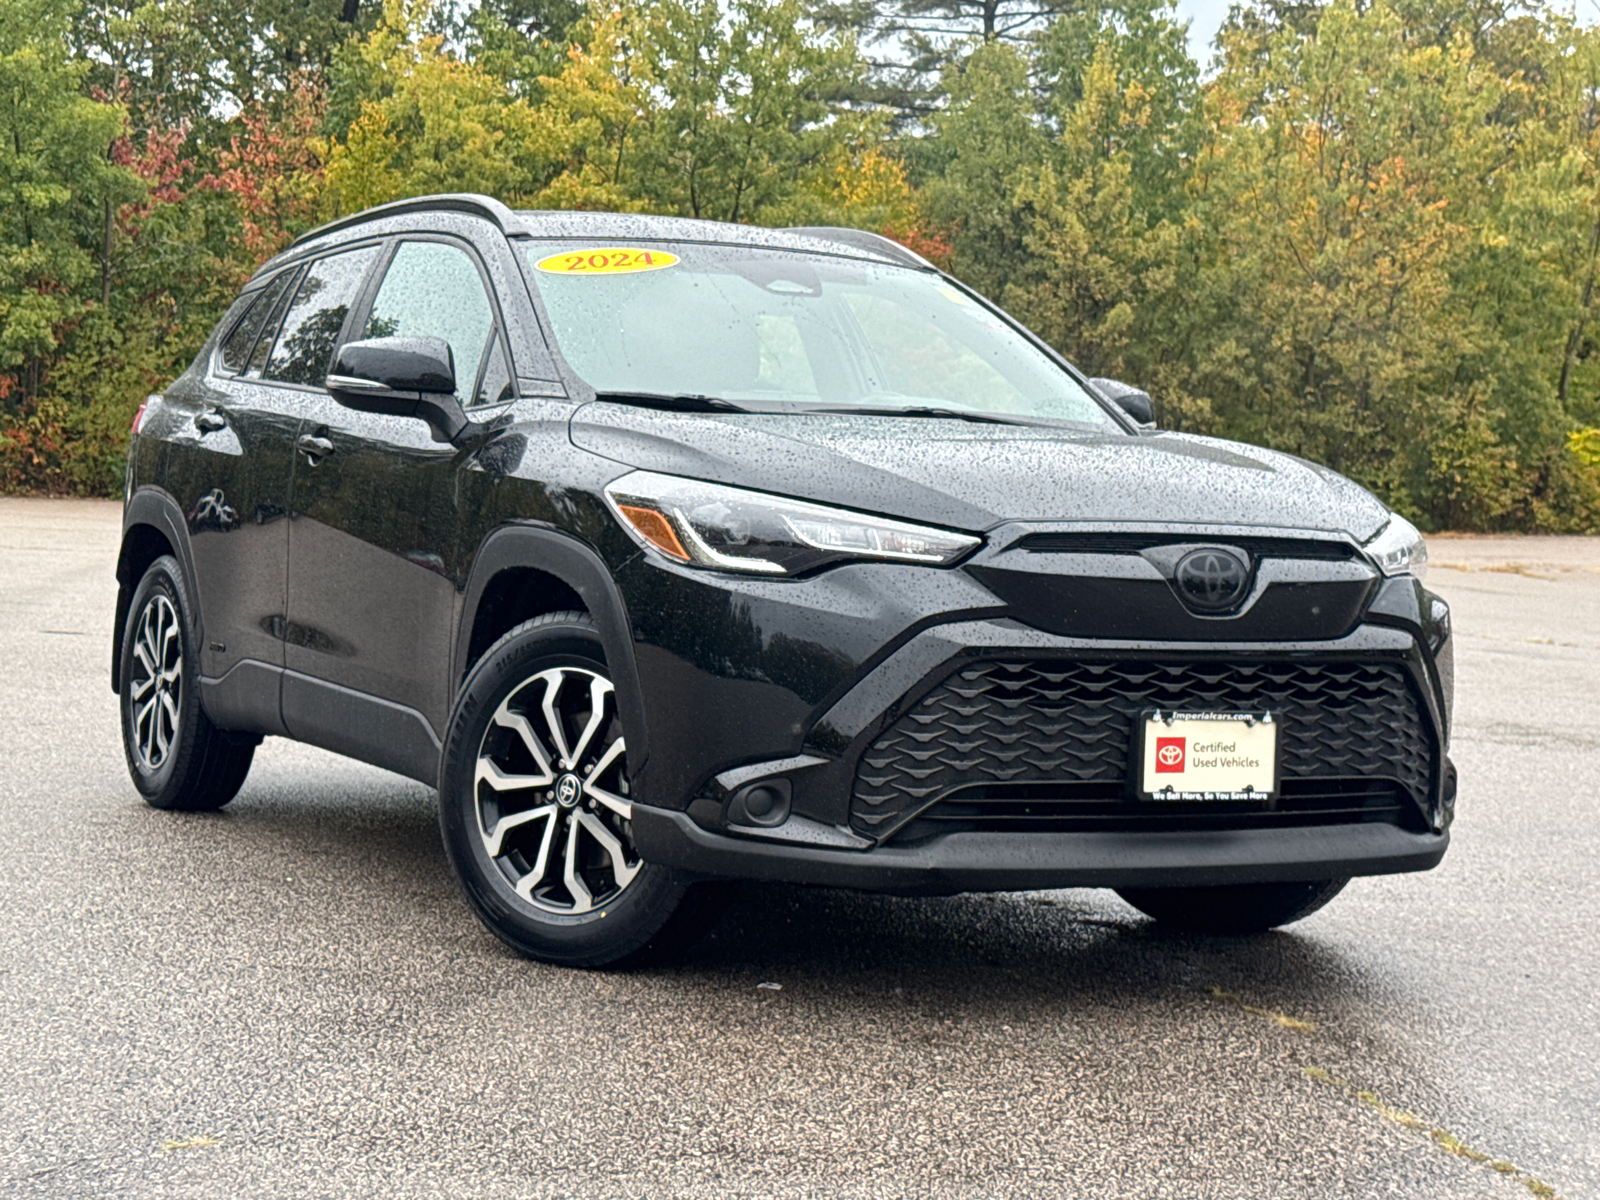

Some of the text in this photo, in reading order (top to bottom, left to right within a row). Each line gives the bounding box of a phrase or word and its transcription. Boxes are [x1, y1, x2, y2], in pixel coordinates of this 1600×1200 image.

[565, 252, 657, 271] 2024
[1172, 711, 1253, 721] Imperialcars.com
[1193, 742, 1236, 753] Certified
[1193, 757, 1259, 768] Used Vehicles
[1153, 792, 1165, 800] We
[1167, 792, 1180, 800] Sell
[1204, 792, 1214, 800] So
[1215, 792, 1229, 800] You
[1250, 792, 1268, 800] More
